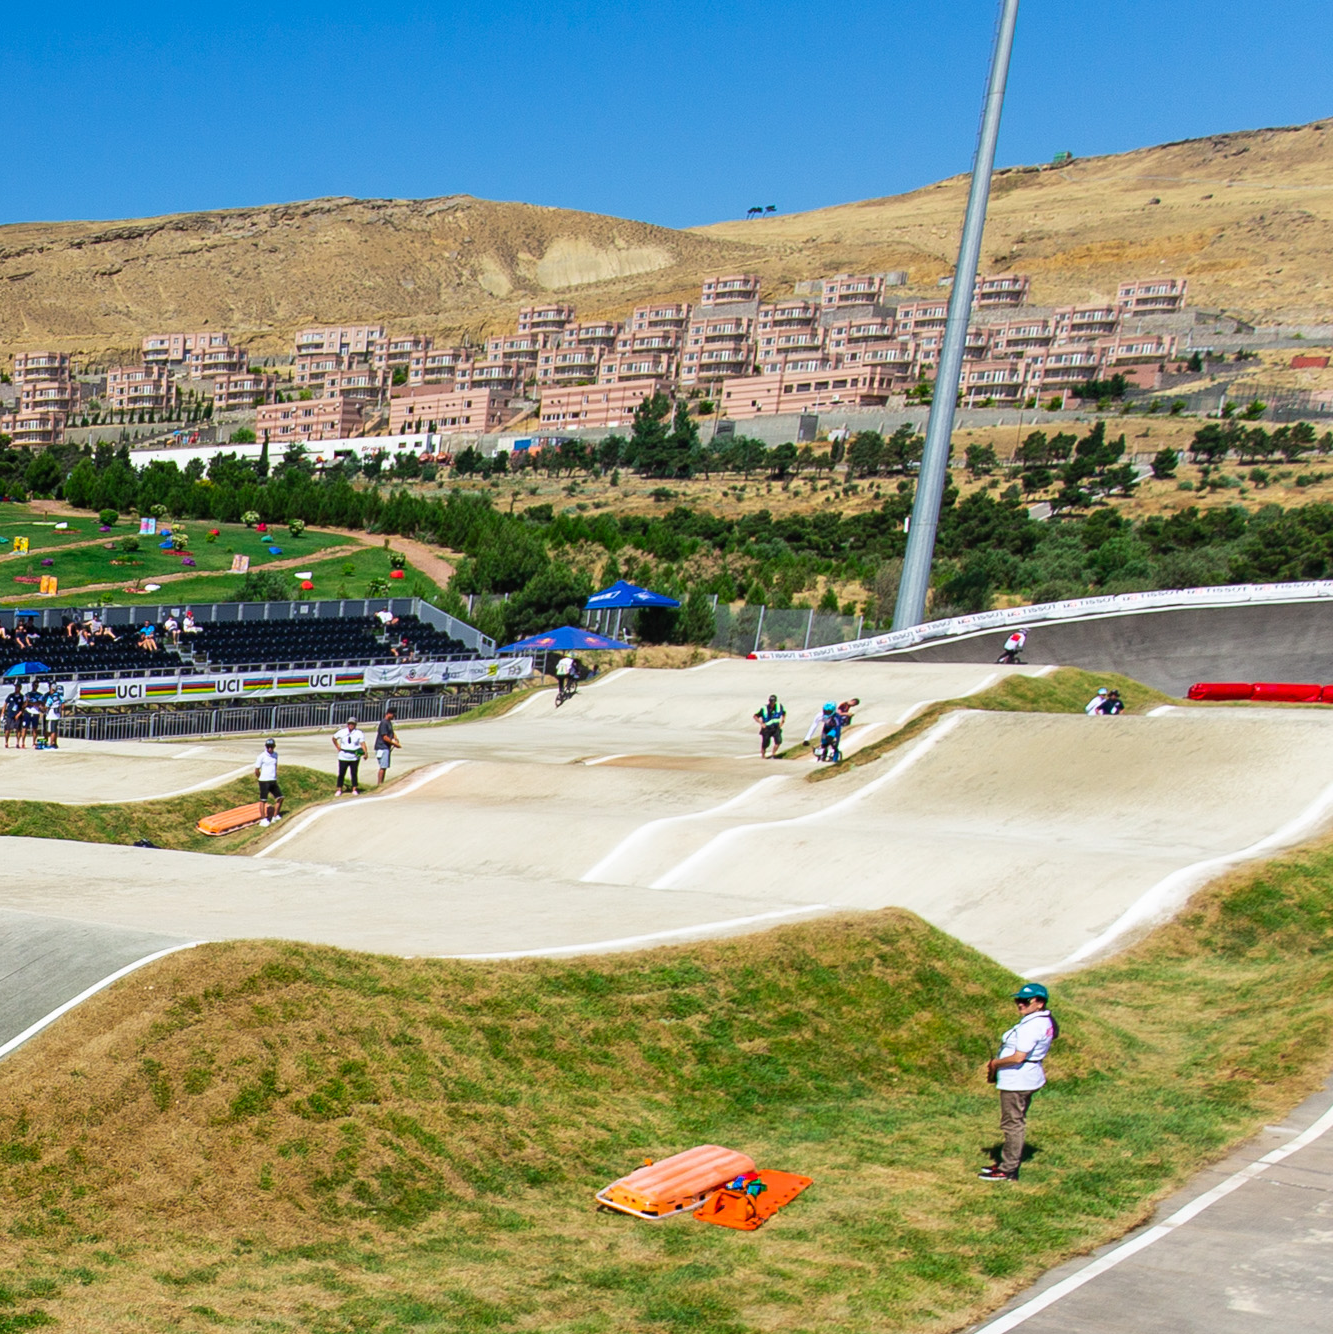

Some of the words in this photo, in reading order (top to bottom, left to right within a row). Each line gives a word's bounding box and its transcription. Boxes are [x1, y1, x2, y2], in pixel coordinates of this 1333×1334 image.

[216, 679, 240, 693] UCI
[309, 674, 332, 688] UCI
[117, 684, 142, 699] UCI
